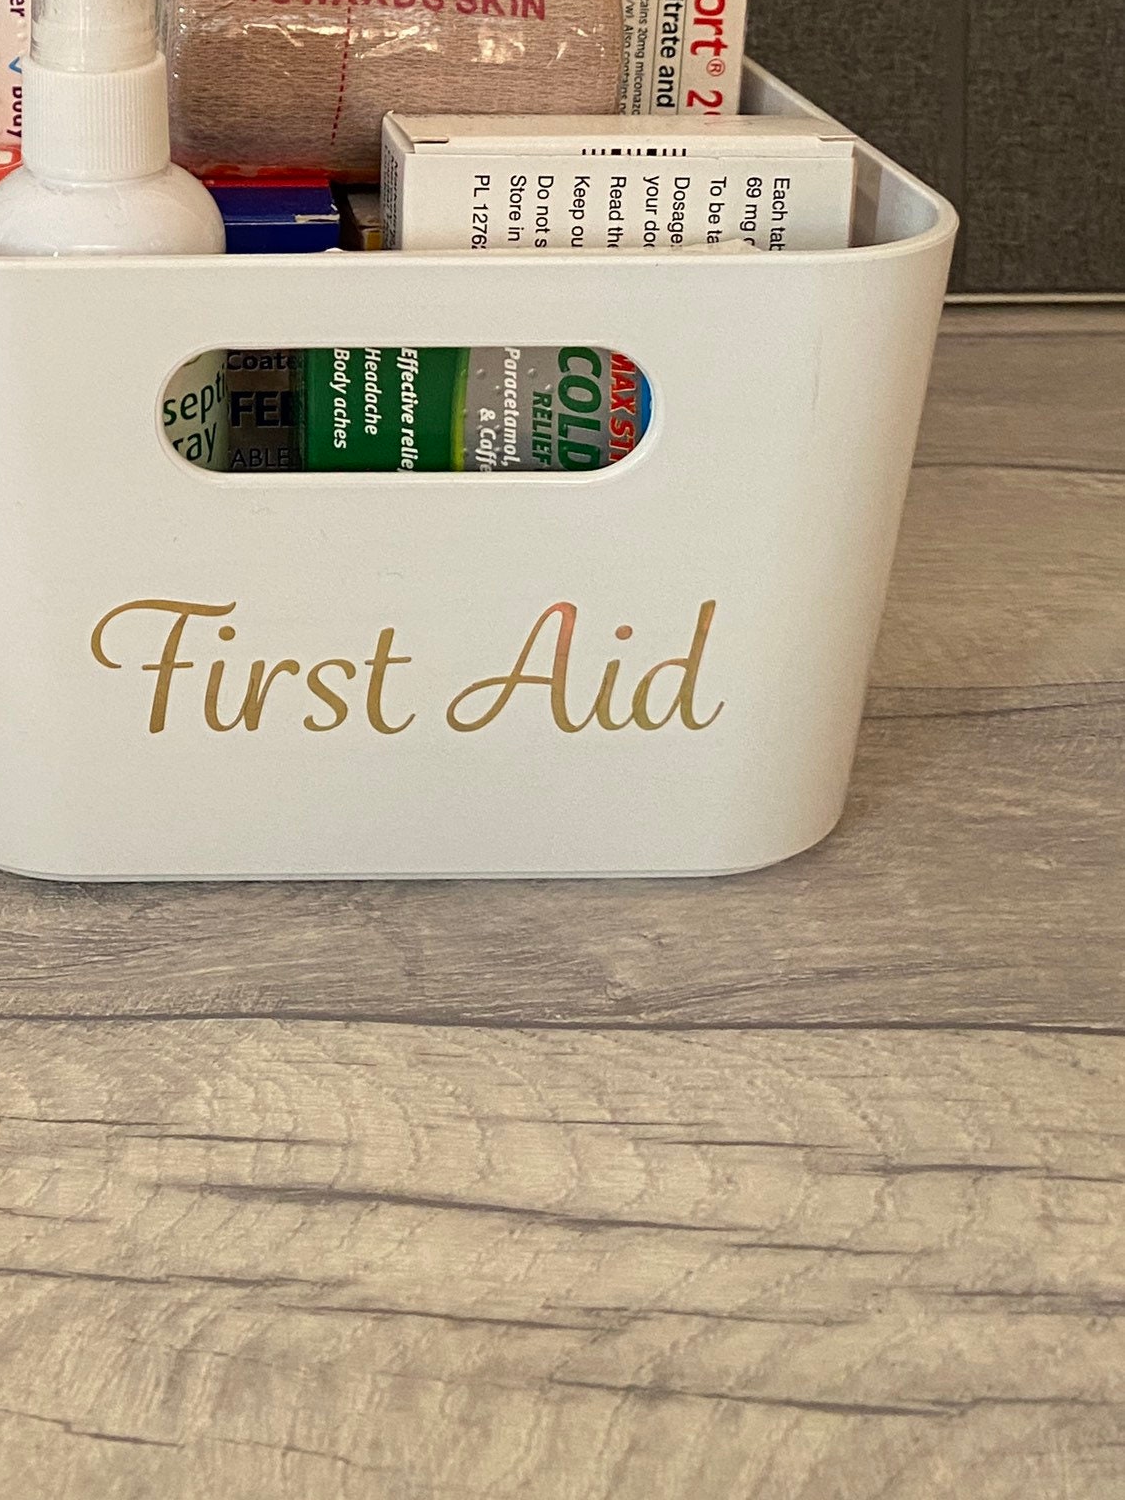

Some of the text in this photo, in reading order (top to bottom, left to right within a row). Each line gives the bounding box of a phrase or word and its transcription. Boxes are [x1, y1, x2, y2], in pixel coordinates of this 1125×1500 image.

[633, 27, 648, 60] 20mg
[655, 64, 676, 108] and
[473, 174, 491, 198] PL
[507, 174, 527, 242] Store in
[536, 175, 555, 200] Do
[568, 175, 591, 221] Keep
[609, 176, 627, 222] Read
[643, 175, 660, 216] your
[709, 176, 727, 197] To
[745, 176, 763, 199] 69
[771, 177, 791, 222] Each
[535, 205, 551, 234] not
[707, 202, 725, 225] be
[739, 203, 758, 232] mg
[329, 347, 352, 449] Body aches
[364, 347, 383, 436] Headache
[396, 347, 420, 425] Effective
[501, 347, 522, 467] Paracetamol,
[479, 407, 496, 422] &
[531, 391, 553, 466] RELIEF
[557, 346, 603, 472] COLD
[90, 597, 726, 735] First Aid
